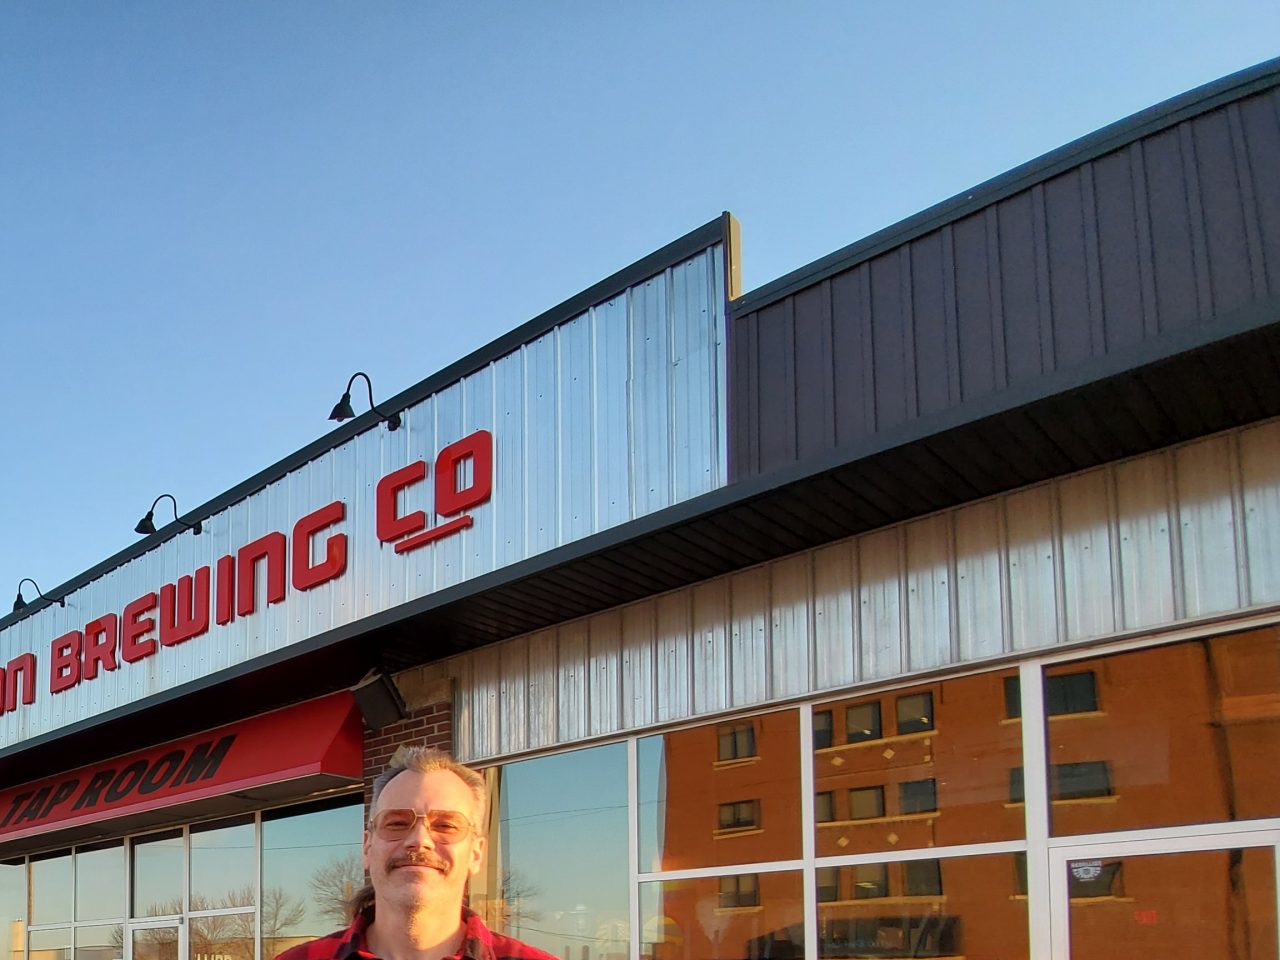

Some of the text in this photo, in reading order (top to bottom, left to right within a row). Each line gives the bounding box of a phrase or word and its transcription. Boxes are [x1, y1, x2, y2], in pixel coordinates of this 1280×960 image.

[50, 500, 347, 695] BREWING
[376, 429, 493, 545] CO
[72, 733, 239, 811] ROOM
